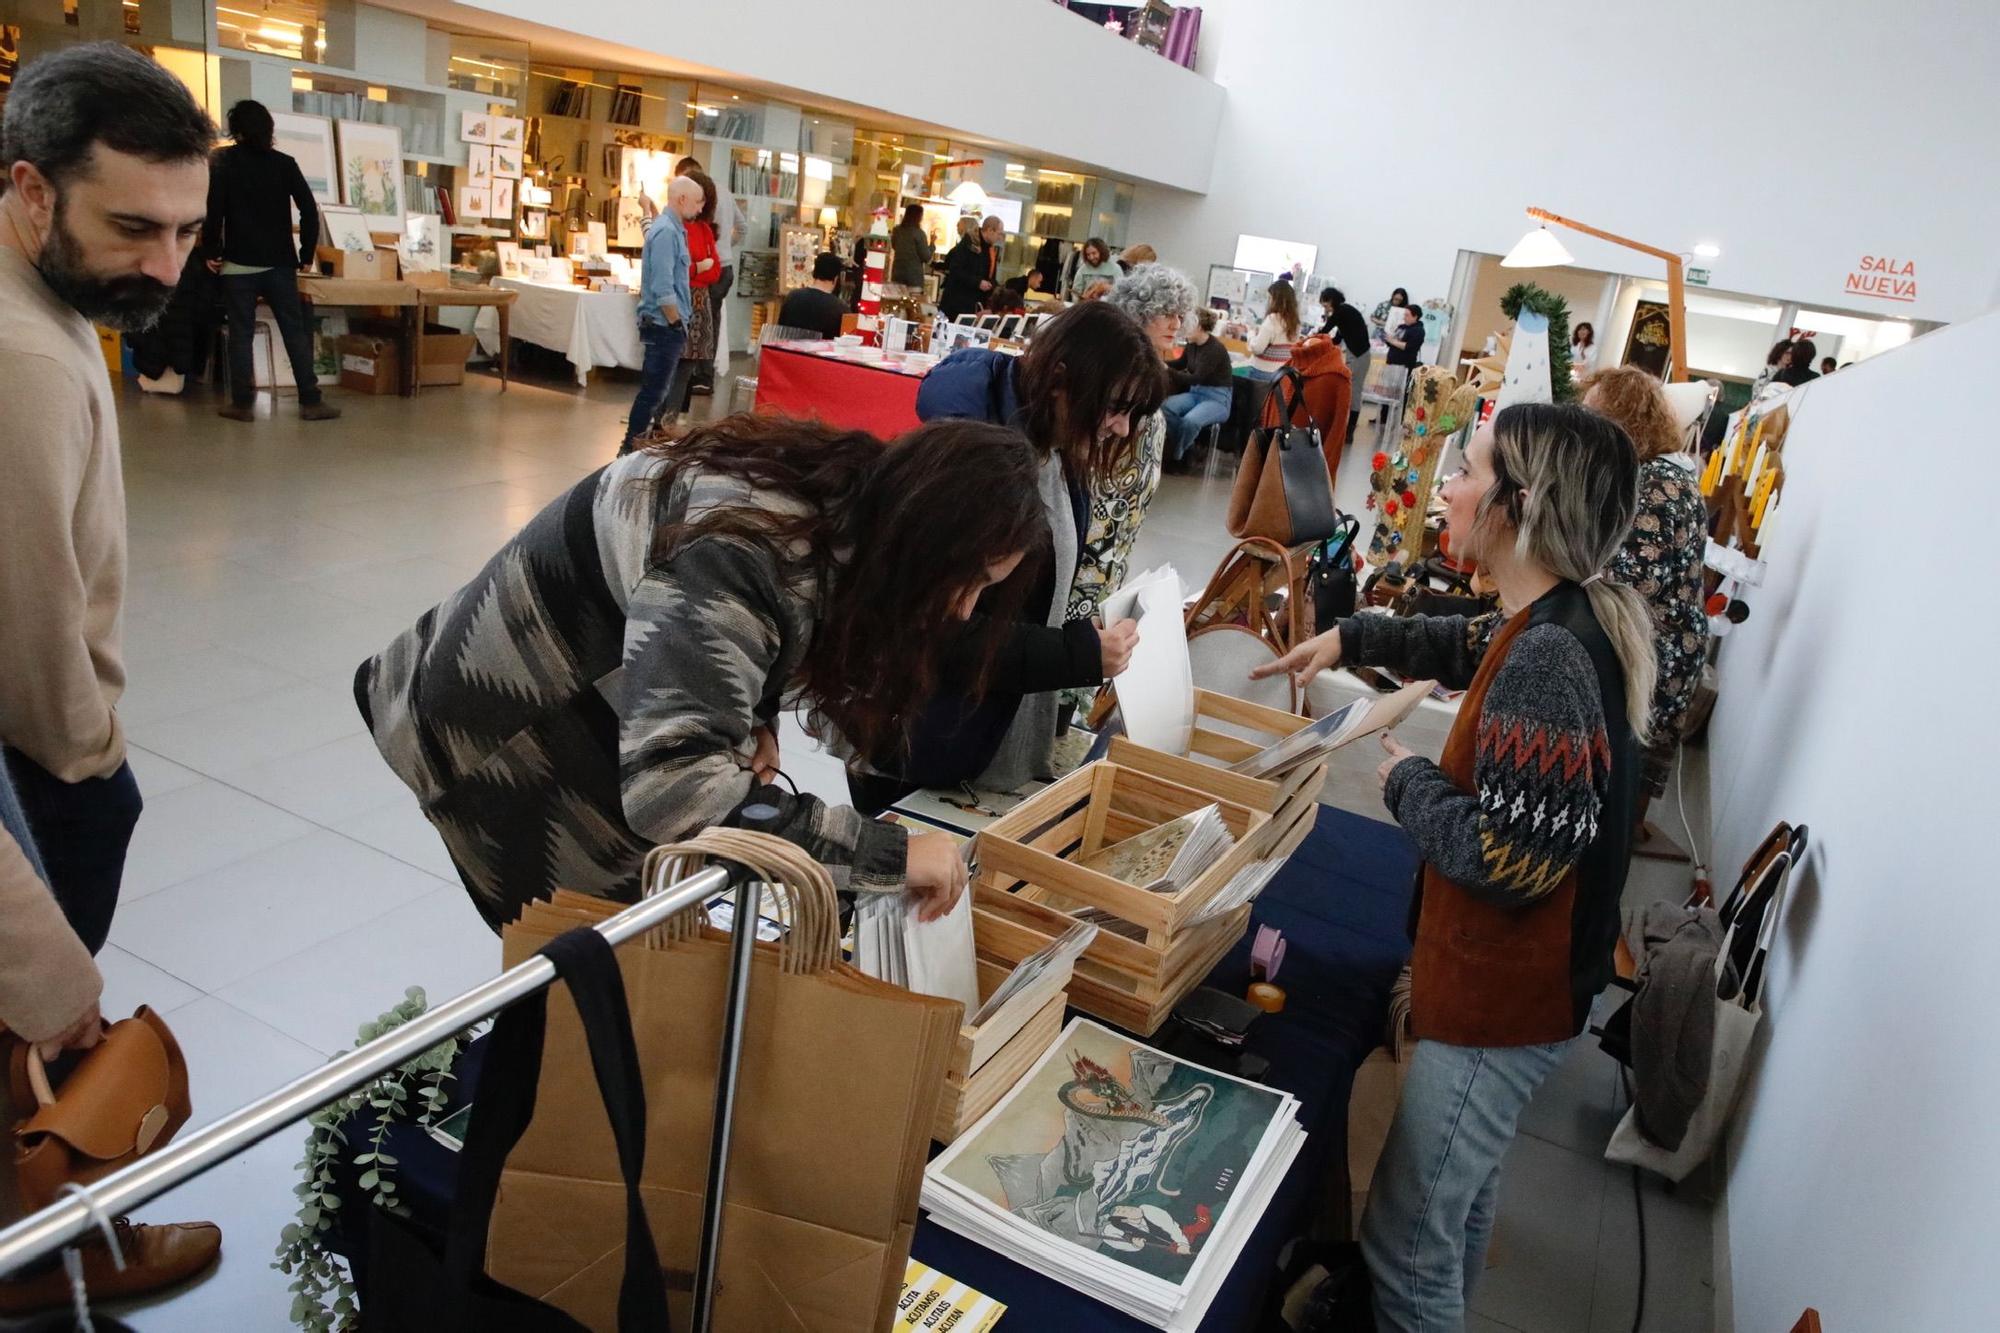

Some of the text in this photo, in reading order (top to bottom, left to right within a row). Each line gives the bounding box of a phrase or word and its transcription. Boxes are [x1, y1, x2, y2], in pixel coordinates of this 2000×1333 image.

[1859, 255, 1915, 276] SALA
[1846, 273, 1917, 297] NUEVA
[899, 1290, 921, 1311] ACUTA
[905, 1289, 940, 1325] ACUTAMOS
[922, 1300, 952, 1329] ACUTAIS
